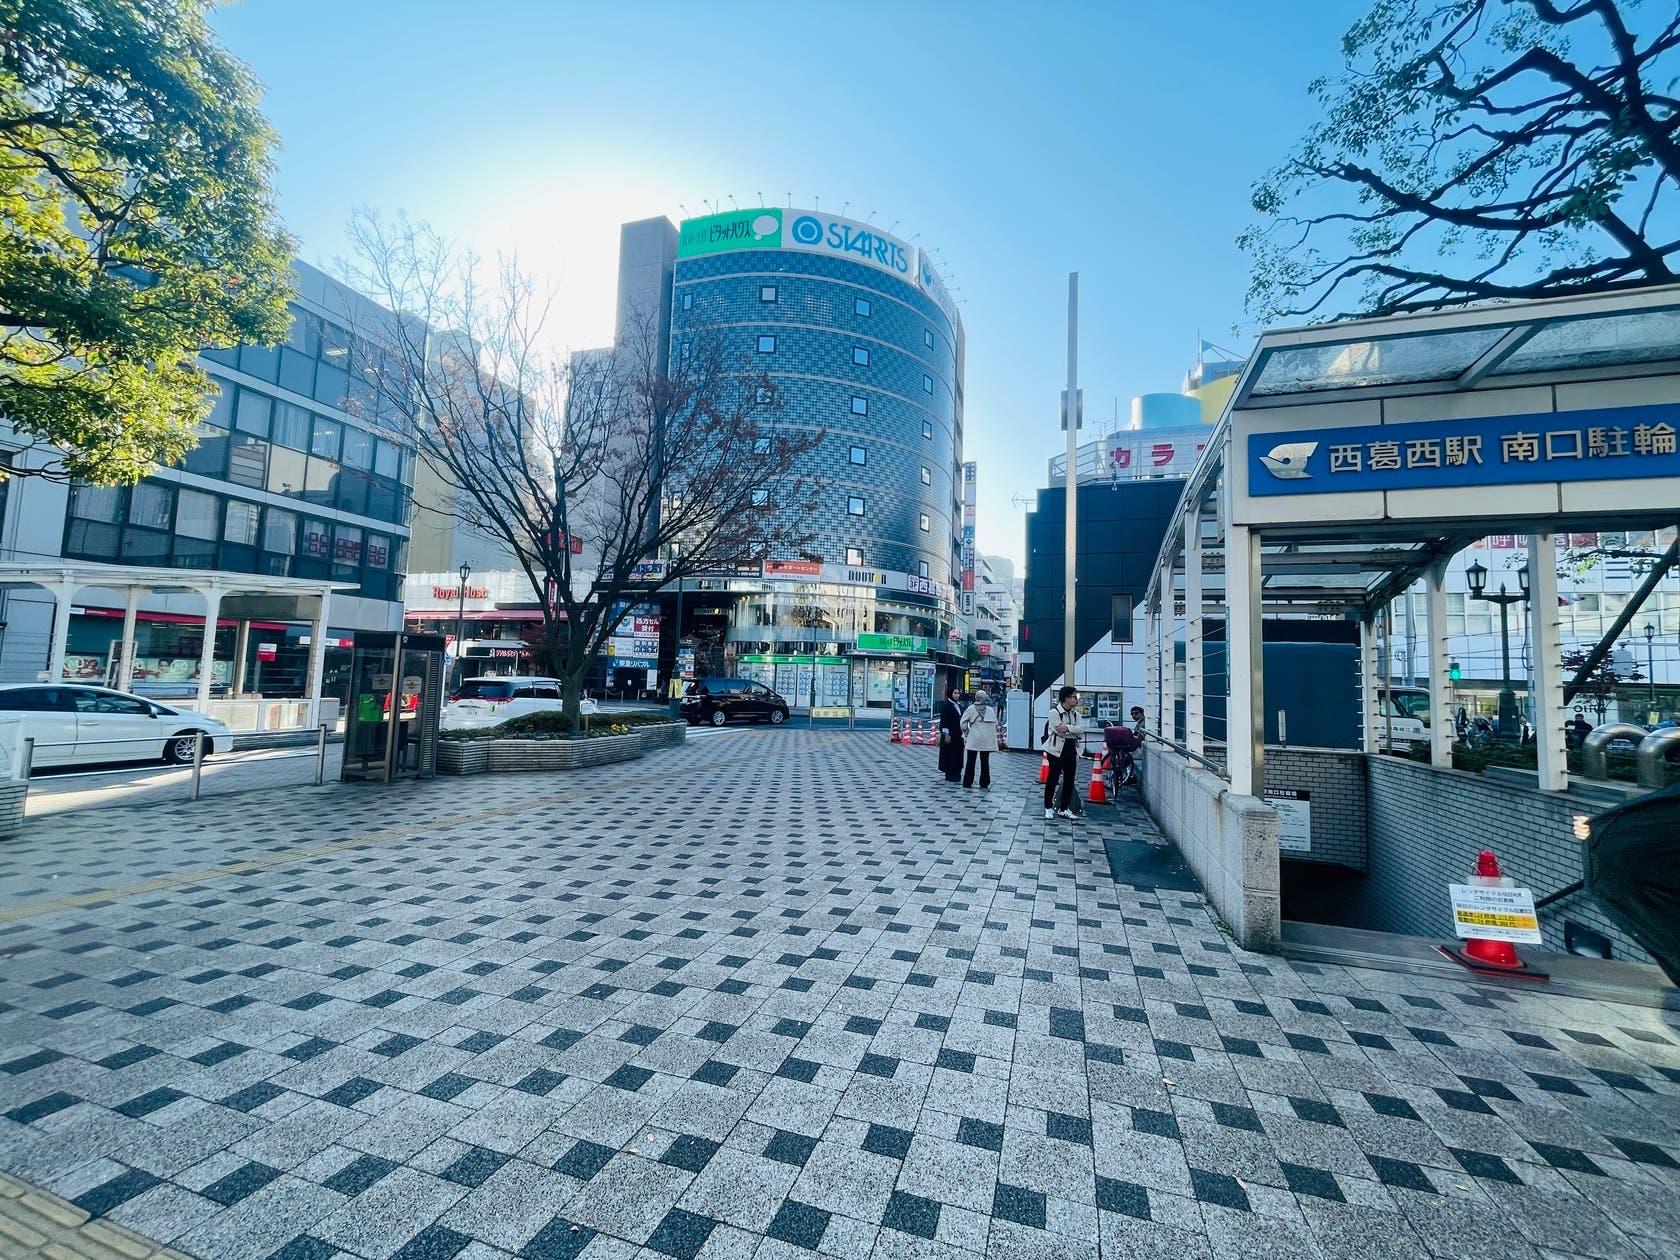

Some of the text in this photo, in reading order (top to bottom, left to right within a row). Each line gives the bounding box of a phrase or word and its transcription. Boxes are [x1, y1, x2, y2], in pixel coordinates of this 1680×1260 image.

[709, 219, 751, 243] ピタットハウス
[826, 222, 908, 274] STARTS
[1109, 443, 1206, 469] カラ
[1327, 421, 1678, 474] 西葛西駅 南口駐輪
[848, 569, 887, 585] DOUTOR
[908, 580, 918, 588] 3F
[432, 586, 488, 600] Royal Host
